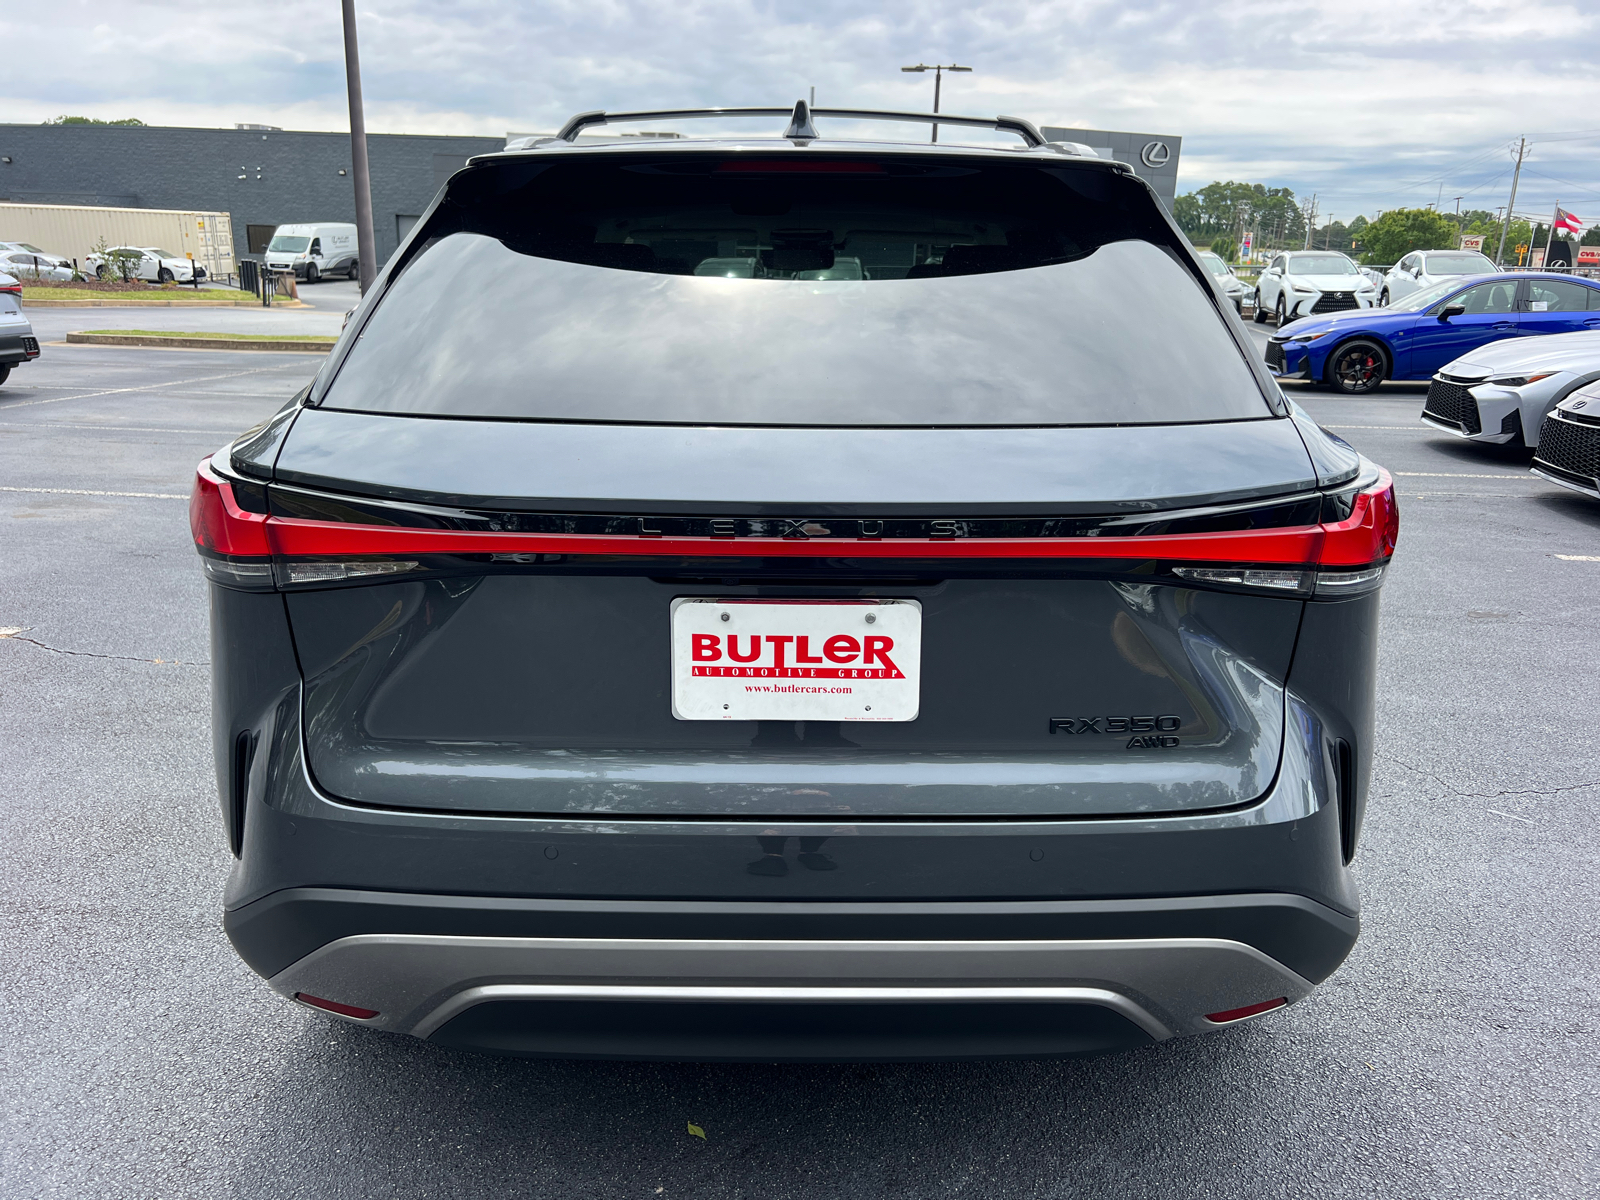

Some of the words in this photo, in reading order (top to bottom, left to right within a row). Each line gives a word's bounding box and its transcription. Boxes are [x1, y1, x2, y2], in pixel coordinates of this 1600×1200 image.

[637, 518, 956, 536] LEXUS
[693, 667, 817, 678] AUTOMOTIVE
[838, 669, 899, 679] GROUP
[744, 684, 853, 695] www.butlercars.com
[1126, 735, 1180, 749] AWD
